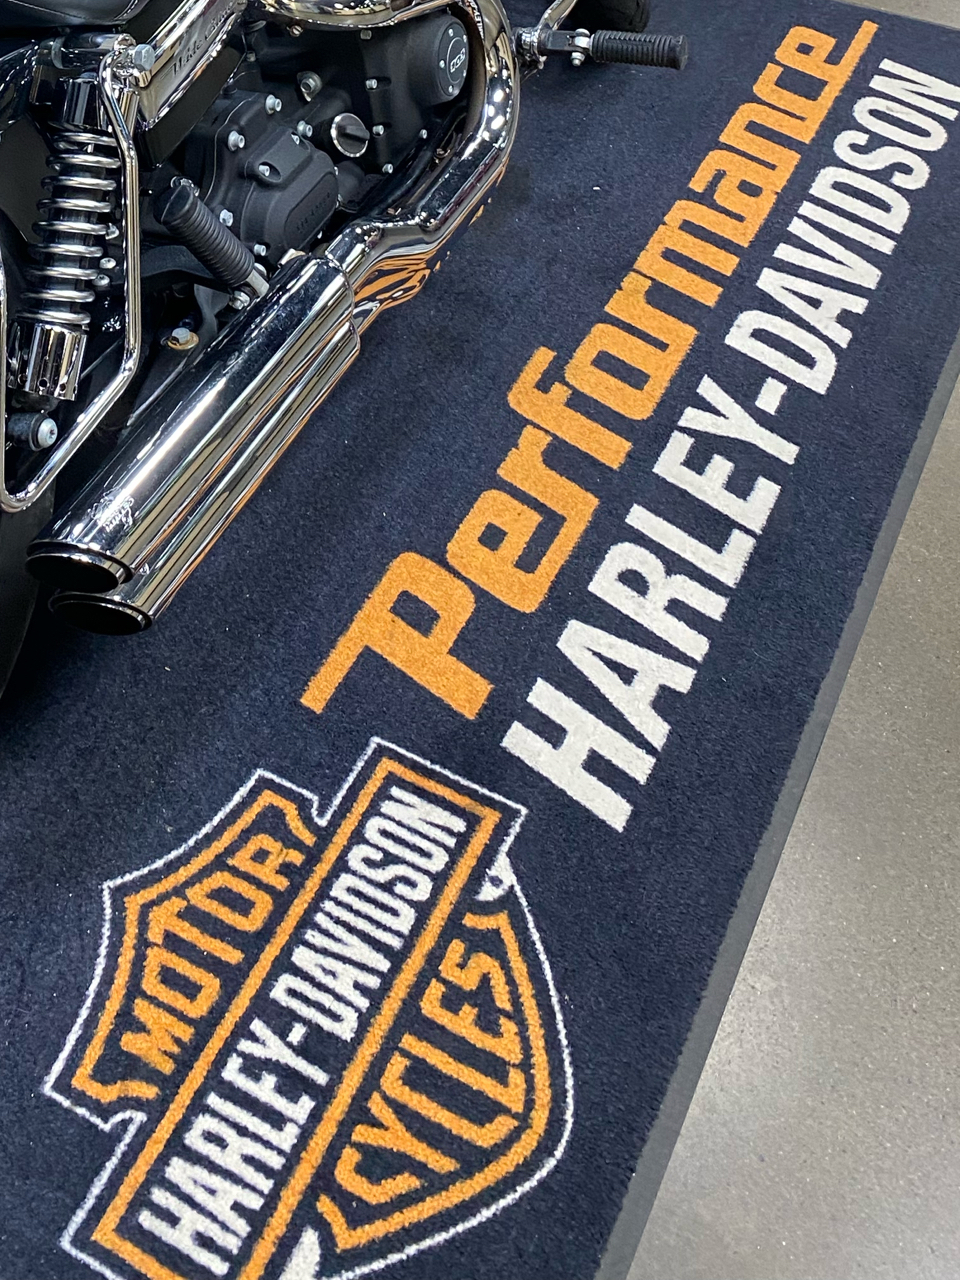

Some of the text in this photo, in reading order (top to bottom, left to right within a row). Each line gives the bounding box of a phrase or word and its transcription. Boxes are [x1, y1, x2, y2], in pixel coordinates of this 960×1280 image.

[300, 19, 880, 720] Performance
[501, 58, 960, 832] HARLEY-DAVIDSON
[120, 833, 305, 1075] MOTOR
[137, 785, 467, 1276] HARLEY-DAVIDSON
[334, 938, 527, 1207] CYCLES
